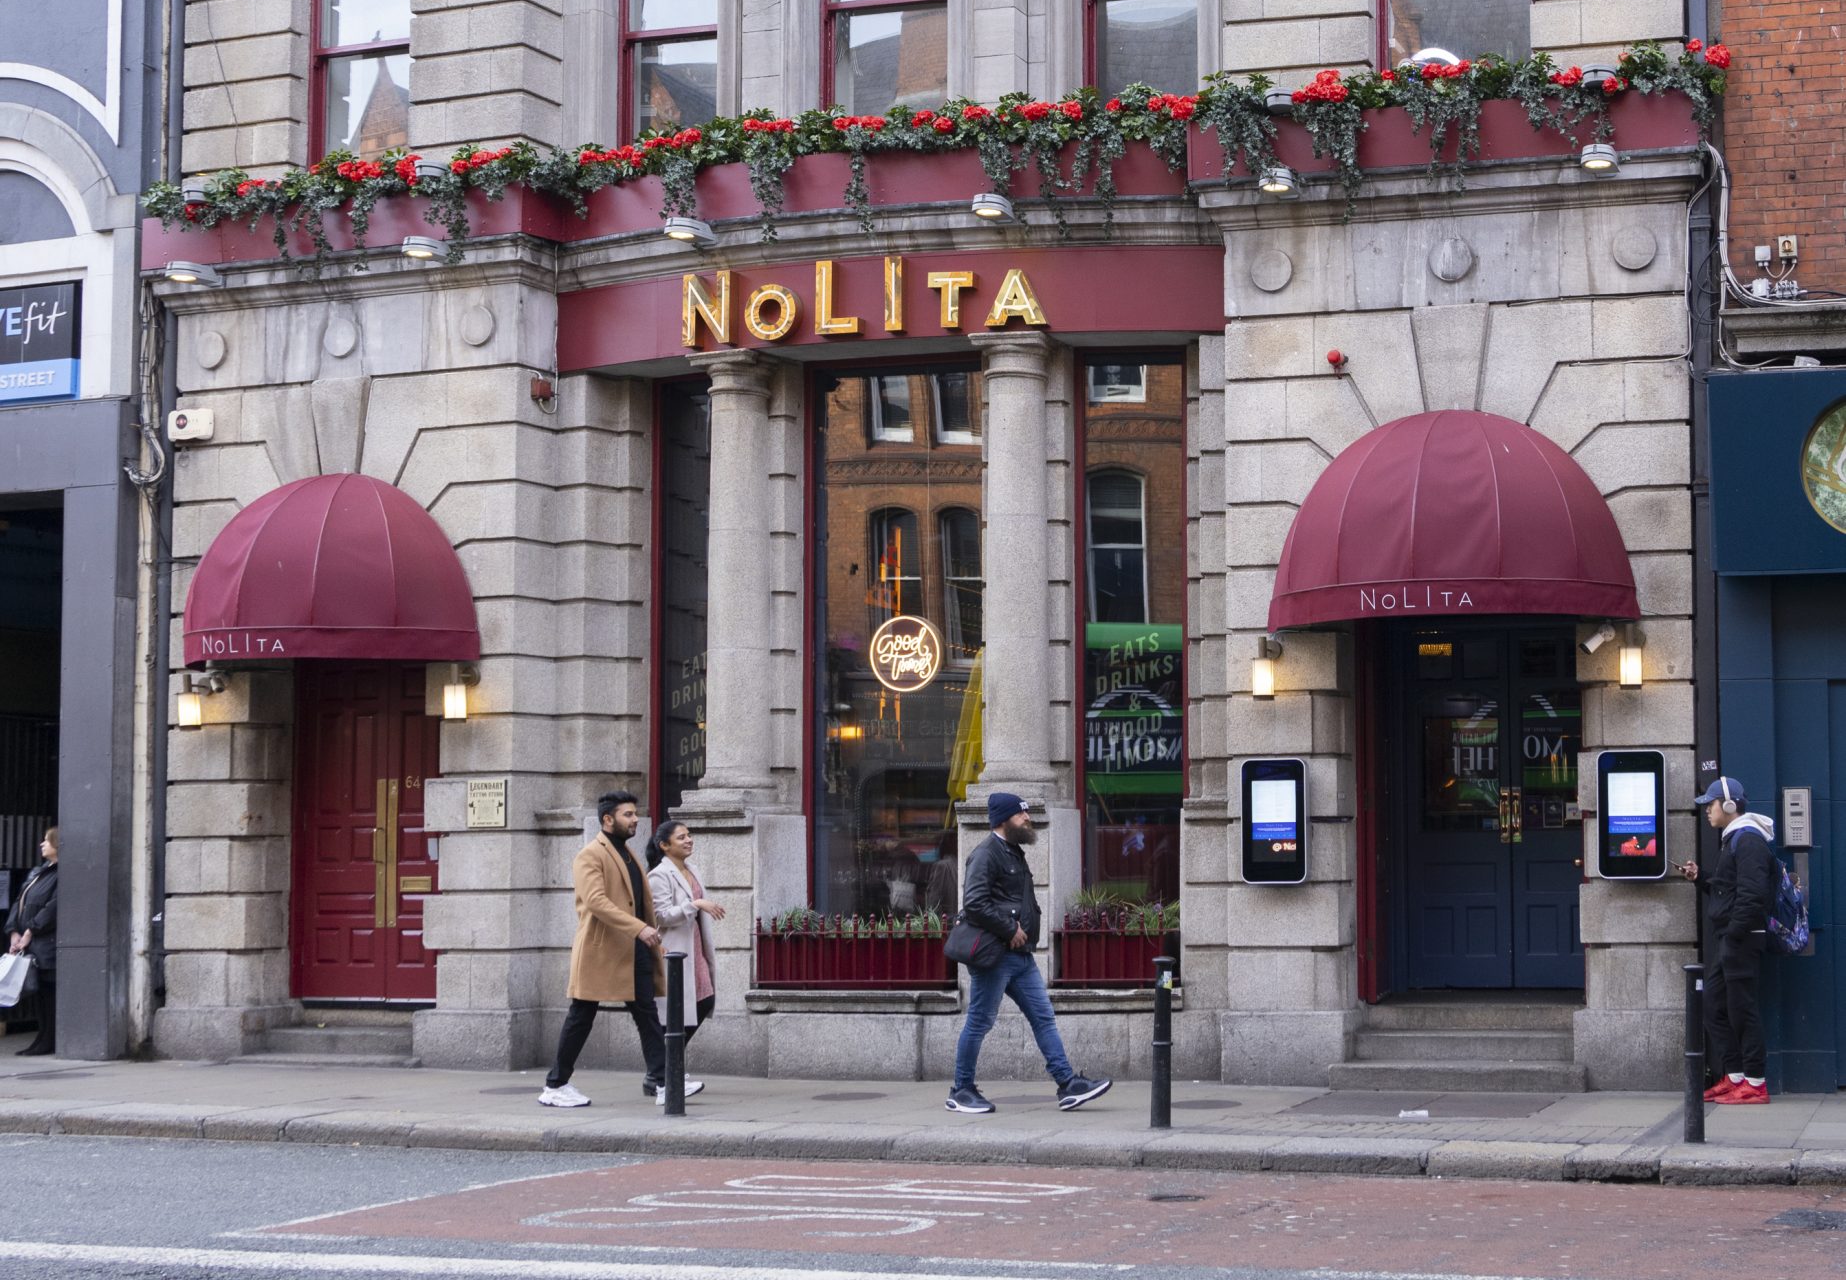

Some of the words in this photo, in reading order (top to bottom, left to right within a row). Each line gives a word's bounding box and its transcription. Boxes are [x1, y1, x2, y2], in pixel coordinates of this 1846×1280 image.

[0, 371, 55, 388] STREET
[1110, 632, 1160, 667] EATS
[682, 651, 707, 679] EAT
[1096, 654, 1174, 696] DRINKS
[672, 678, 706, 709] DRIN
[1129, 692, 1141, 712] &
[695, 705, 705, 723] &
[680, 729, 706, 757] GOO
[1108, 712, 1162, 746] GOOD
[676, 755, 703, 783] TIM
[1105, 736, 1168, 774] TIMES
[405, 775, 421, 789] 64
[469, 782, 503, 792] LEGENDARY
